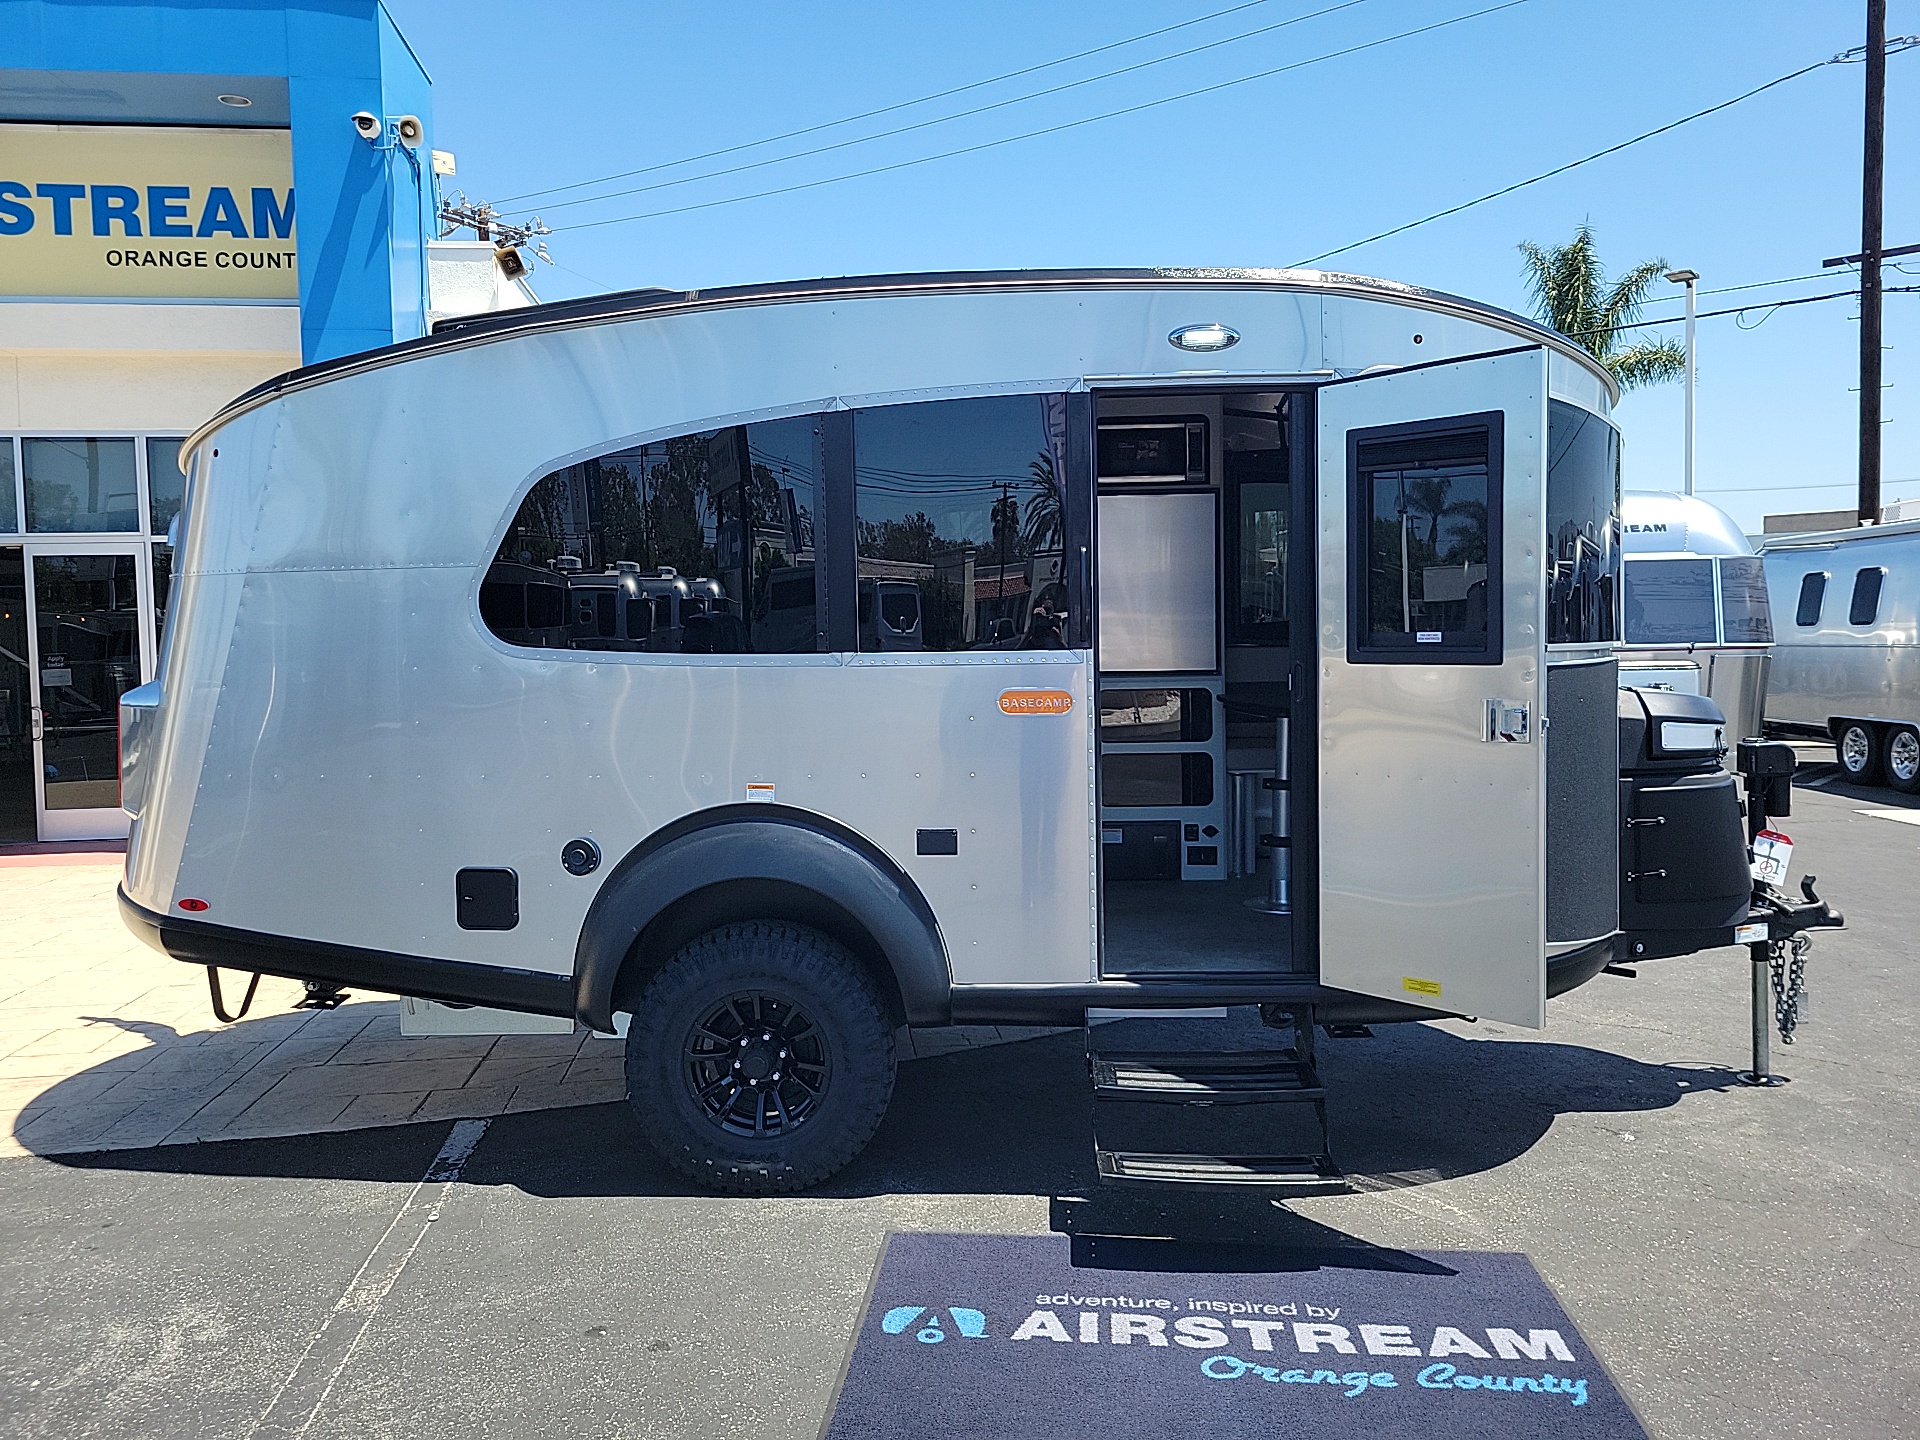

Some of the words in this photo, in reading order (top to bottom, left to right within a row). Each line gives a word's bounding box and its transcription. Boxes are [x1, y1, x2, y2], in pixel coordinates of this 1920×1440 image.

[105, 249, 208, 268] ORANGE
[214, 251, 296, 269] COUNT
[1001, 698, 1071, 708] BASECAMP
[1035, 1293, 1179, 1311] adventure,
[1188, 1298, 1297, 1318] inspired
[1305, 1302, 1341, 1320] by
[1010, 1310, 1576, 1362] AIRSTREAM
[1200, 1355, 1399, 1397] Orange
[1416, 1362, 1589, 1407] County
